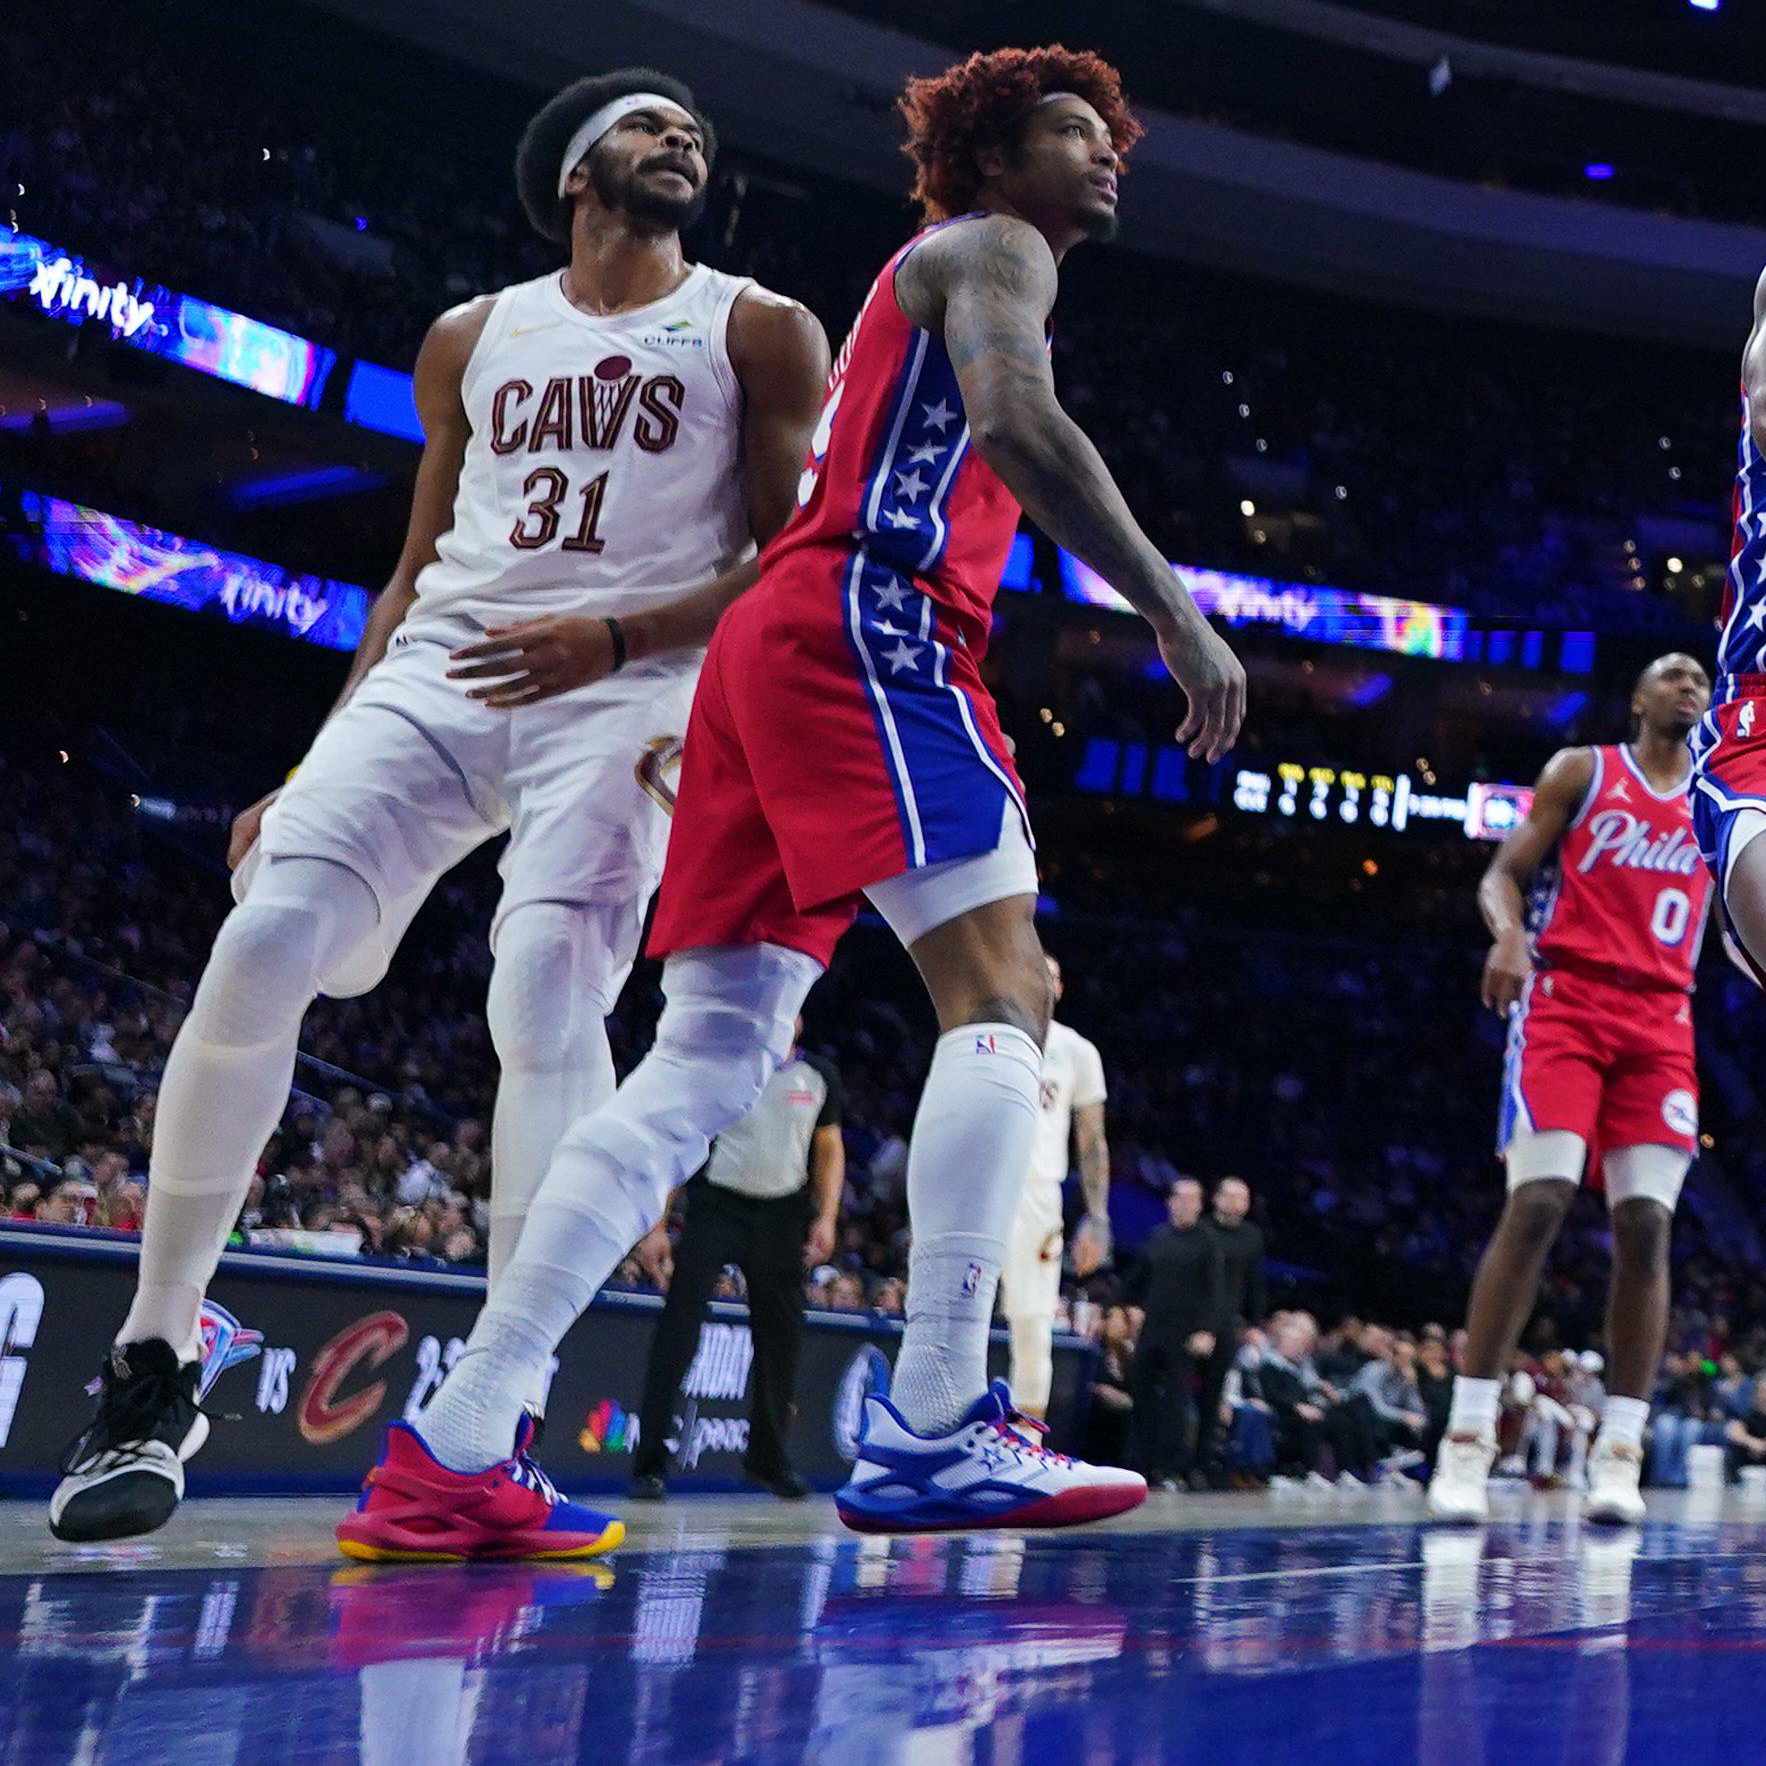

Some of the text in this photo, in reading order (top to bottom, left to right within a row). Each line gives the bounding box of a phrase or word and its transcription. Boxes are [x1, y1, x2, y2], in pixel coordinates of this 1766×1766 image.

[29, 257, 155, 337] xfinity
[491, 374, 686, 456] CAVS
[509, 466, 610, 552] 31
[1577, 808, 1701, 876] Phila
[1651, 887, 1690, 947] 0
